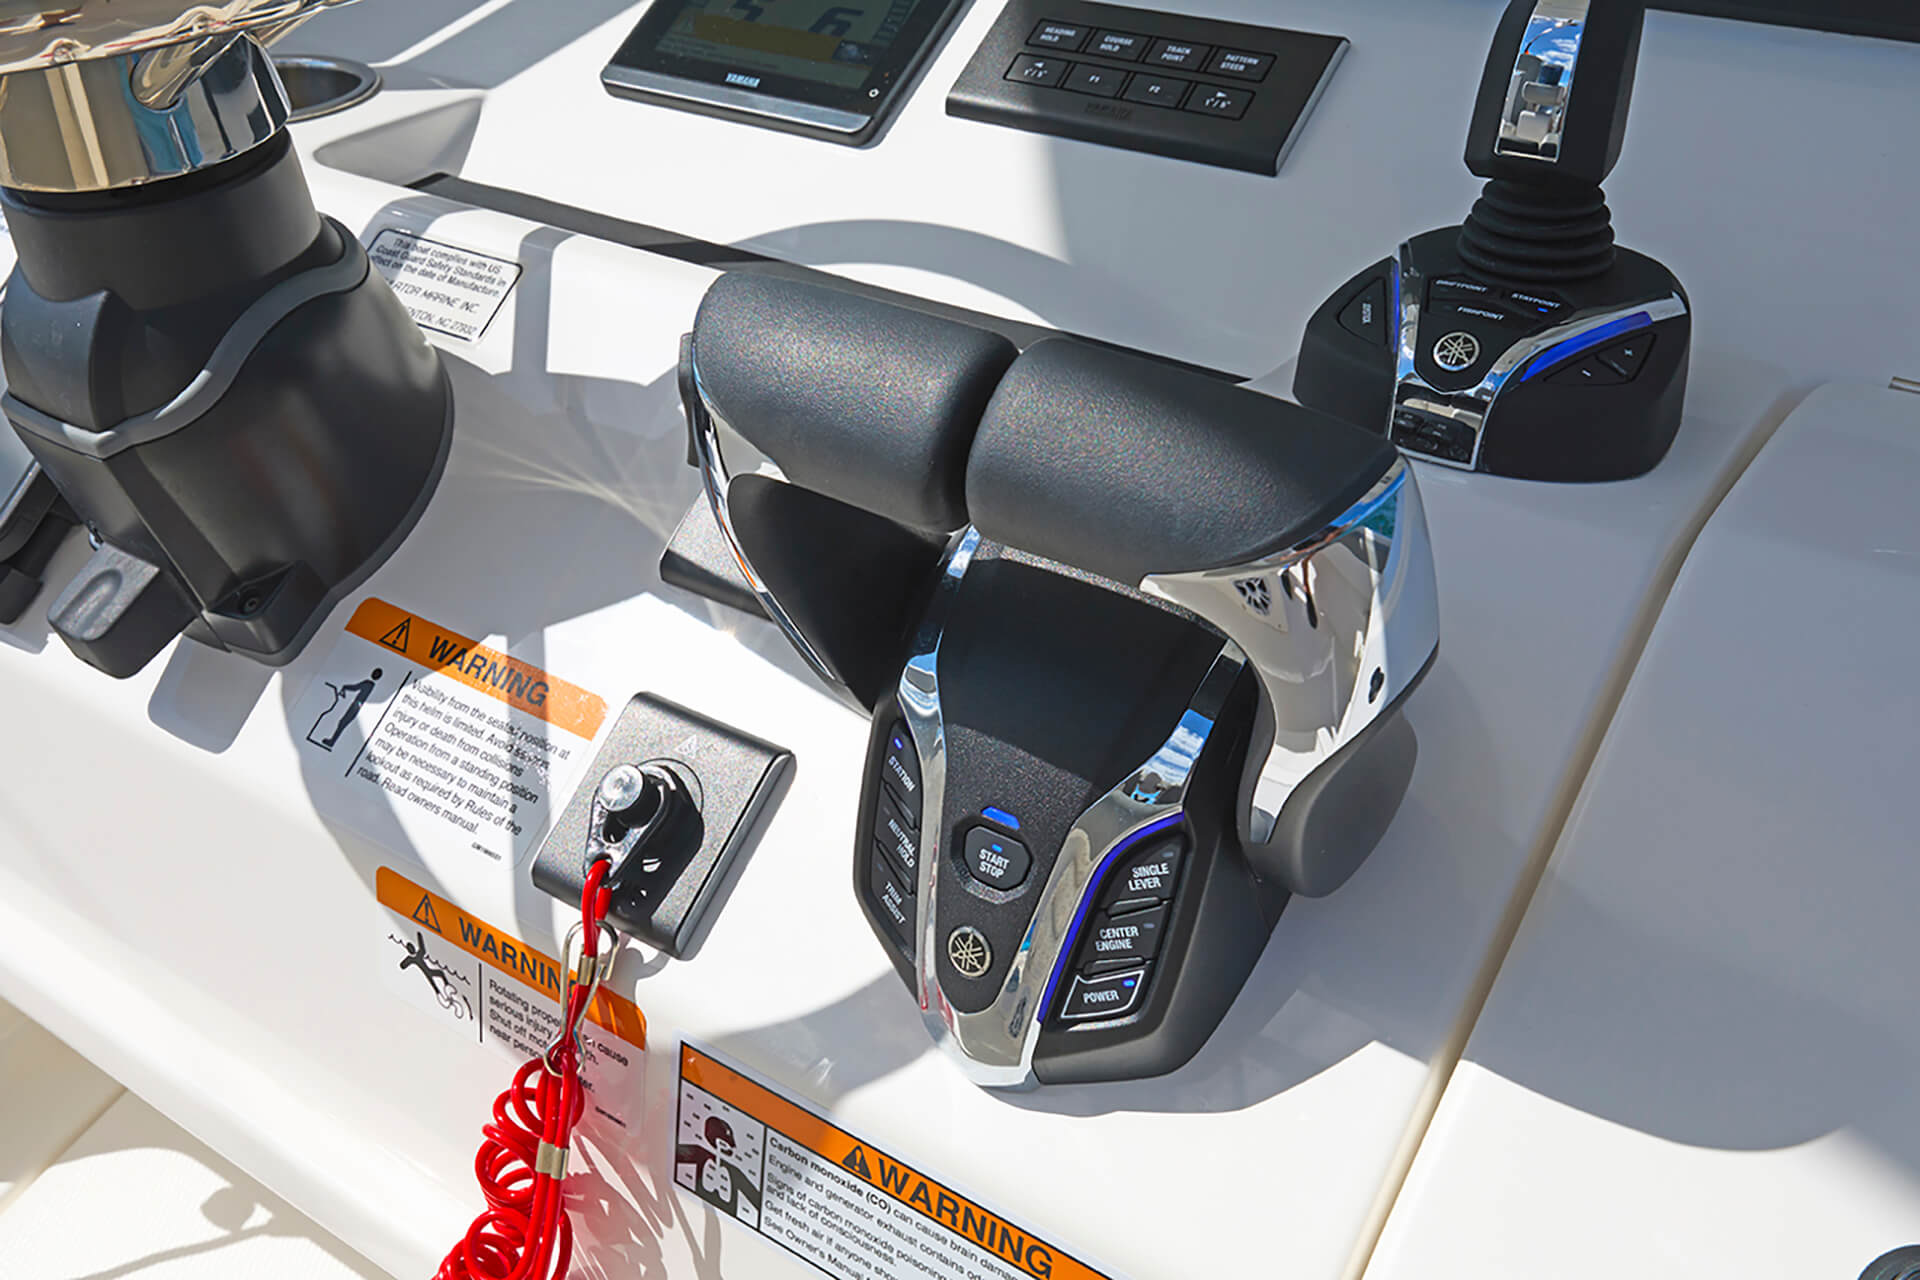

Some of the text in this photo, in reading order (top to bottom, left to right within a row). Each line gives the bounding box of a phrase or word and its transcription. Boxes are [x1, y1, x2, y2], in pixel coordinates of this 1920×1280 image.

[1045, 27, 1076, 36] HEADING
[1104, 35, 1134, 46] COURSE
[1161, 53, 1184, 62] POINT
[1166, 46, 1192, 54] TRACK
[1225, 54, 1259, 64] PATTERN
[726, 72, 760, 88] YAMAHA
[1220, 62, 1246, 71] STEER
[376, 245, 506, 286] Coast Guard Safety Standards in
[394, 238, 411, 250] This
[412, 242, 431, 254] boat
[469, 257, 487, 268] with
[488, 264, 503, 274] US
[403, 264, 417, 274] the
[418, 268, 436, 280] date
[437, 272, 448, 282] of
[422, 288, 461, 308] MARINE
[461, 302, 480, 313] INC
[1458, 306, 1504, 320] FISHPOINT
[1512, 292, 1560, 308] STAYPOINT
[438, 317, 452, 327] NC
[428, 635, 550, 708] WARNING
[402, 694, 418, 708] this
[419, 702, 443, 720] helm
[443, 712, 453, 724] is
[392, 707, 418, 728] injury
[418, 722, 430, 732] or
[430, 727, 457, 744] death
[457, 738, 480, 756] from
[448, 696, 470, 714] from
[470, 707, 486, 721] the
[558, 749, 571, 760] at
[375, 738, 518, 814] may be necessary to maintain a
[384, 722, 538, 804] Operation from a standing position
[888, 755, 916, 792] STATION
[366, 750, 522, 836] lookout as required by Rules of the
[381, 777, 408, 798] Read
[407, 792, 442, 815] owners
[441, 809, 479, 834] manual.
[888, 819, 917, 857] NEUTRAL
[896, 844, 916, 868] HOLD
[978, 848, 1010, 870] START
[978, 861, 1004, 878] STOP
[1132, 862, 1170, 878] SINGLE
[885, 880, 903, 906] TRIM
[1128, 876, 1162, 892] LEVER
[882, 894, 906, 924] ASSIST
[1096, 938, 1134, 952] ENGINE
[1099, 926, 1140, 940] CENTER
[458, 916, 577, 998] WARNIN
[1083, 990, 1121, 1004] POWER
[489, 996, 553, 1039] serious injury
[489, 979, 528, 1012] Rotating
[598, 1043, 629, 1066] cause
[489, 1008, 512, 1031] Shut
[513, 1023, 527, 1038] off
[489, 1024, 512, 1043] near
[767, 1172, 794, 1196] Signs
[796, 1190, 808, 1202] of
[808, 1198, 844, 1226] carbon
[844, 1219, 894, 1254] monoxide
[768, 1154, 802, 1181] Engine
[804, 1176, 824, 1193] and
[826, 1188, 874, 1222] generator
[876, 1218, 918, 1248] exhaust
[920, 1243, 964, 1274] contains
[770, 1136, 808, 1166] Carbon
[810, 1161, 864, 1197] monoxide
[866, 1191, 892, 1214] (CO)
[893, 1208, 914, 1226] can
[915, 1220, 948, 1245] cause
[950, 1238, 978, 1262] brain
[766, 1184, 897, 1266] and lack of consciousness.
[878, 1157, 1053, 1280] WARNING
[764, 1216, 784, 1235] See
[785, 1229, 825, 1260] Owner's
[765, 1200, 784, 1218] Get
[785, 1212, 810, 1233] fresh
[812, 1229, 824, 1241] air
[826, 1235, 833, 1246] if
[834, 1243, 872, 1270] anyone
